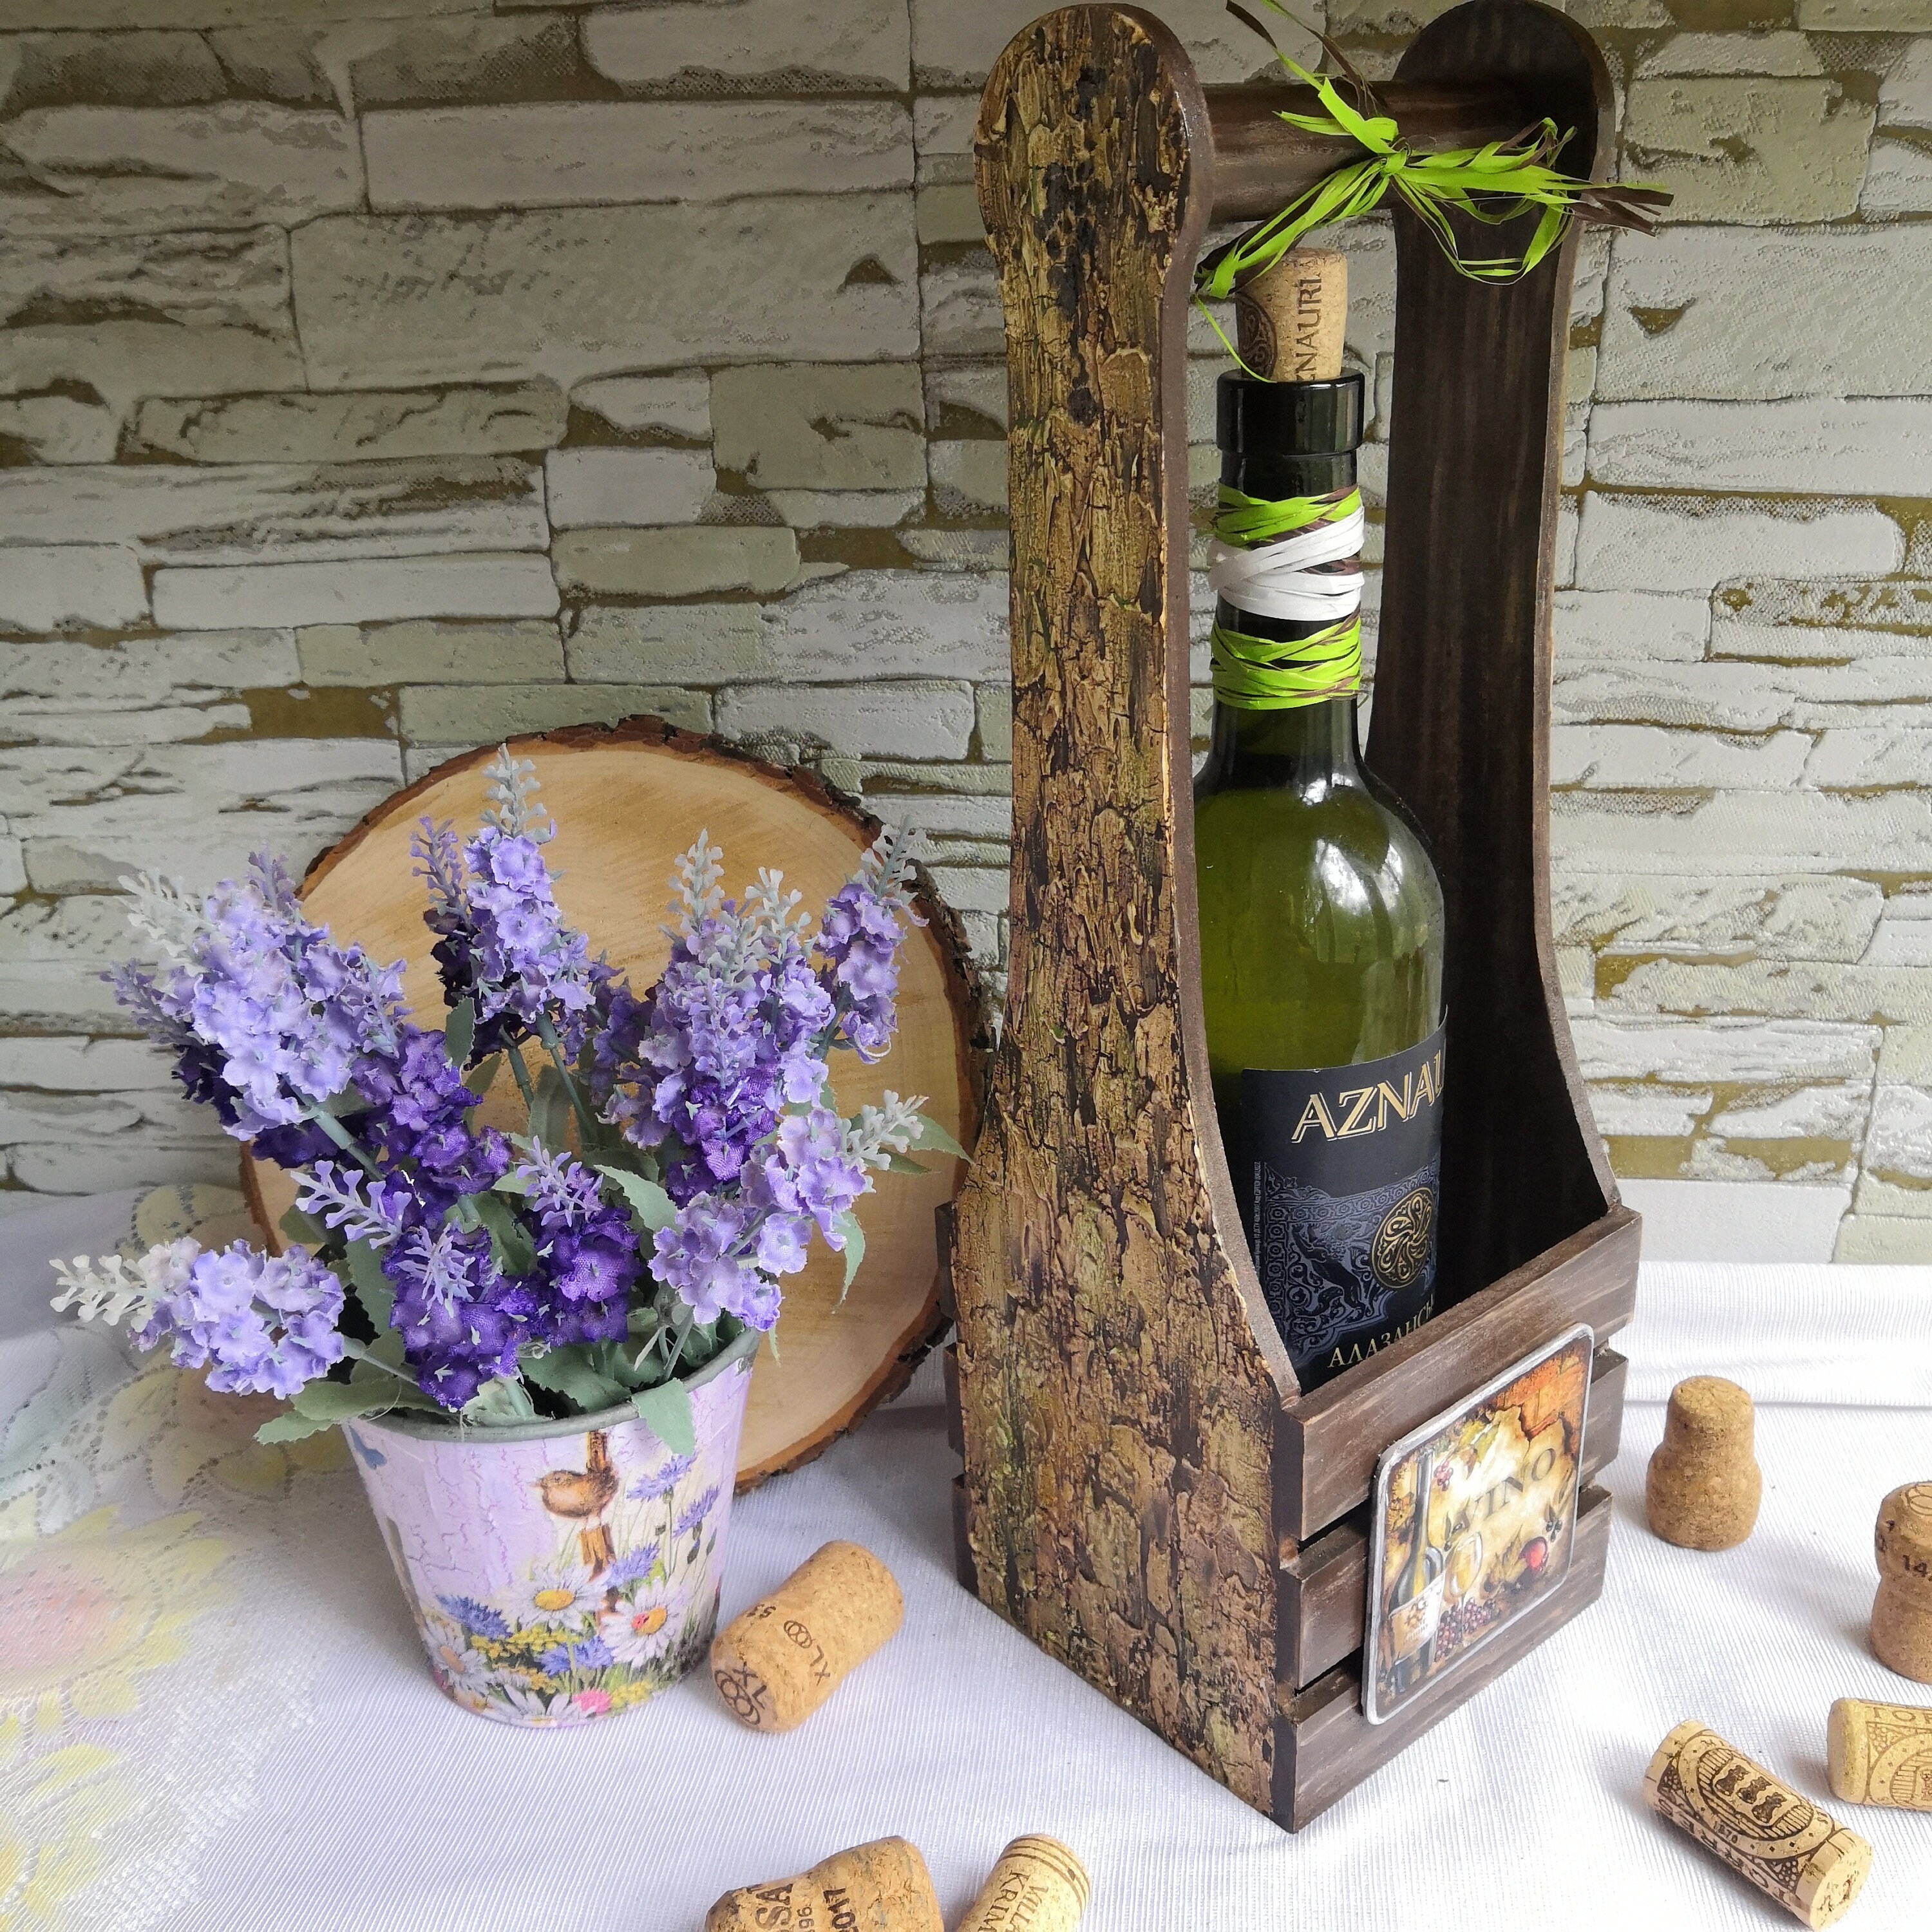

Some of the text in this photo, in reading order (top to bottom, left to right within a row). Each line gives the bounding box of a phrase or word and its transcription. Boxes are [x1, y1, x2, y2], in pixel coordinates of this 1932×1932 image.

[1294, 278, 1322, 381] NAURI
[1457, 1447, 1557, 1533] VINO
[732, 1660, 768, 1710] XL
